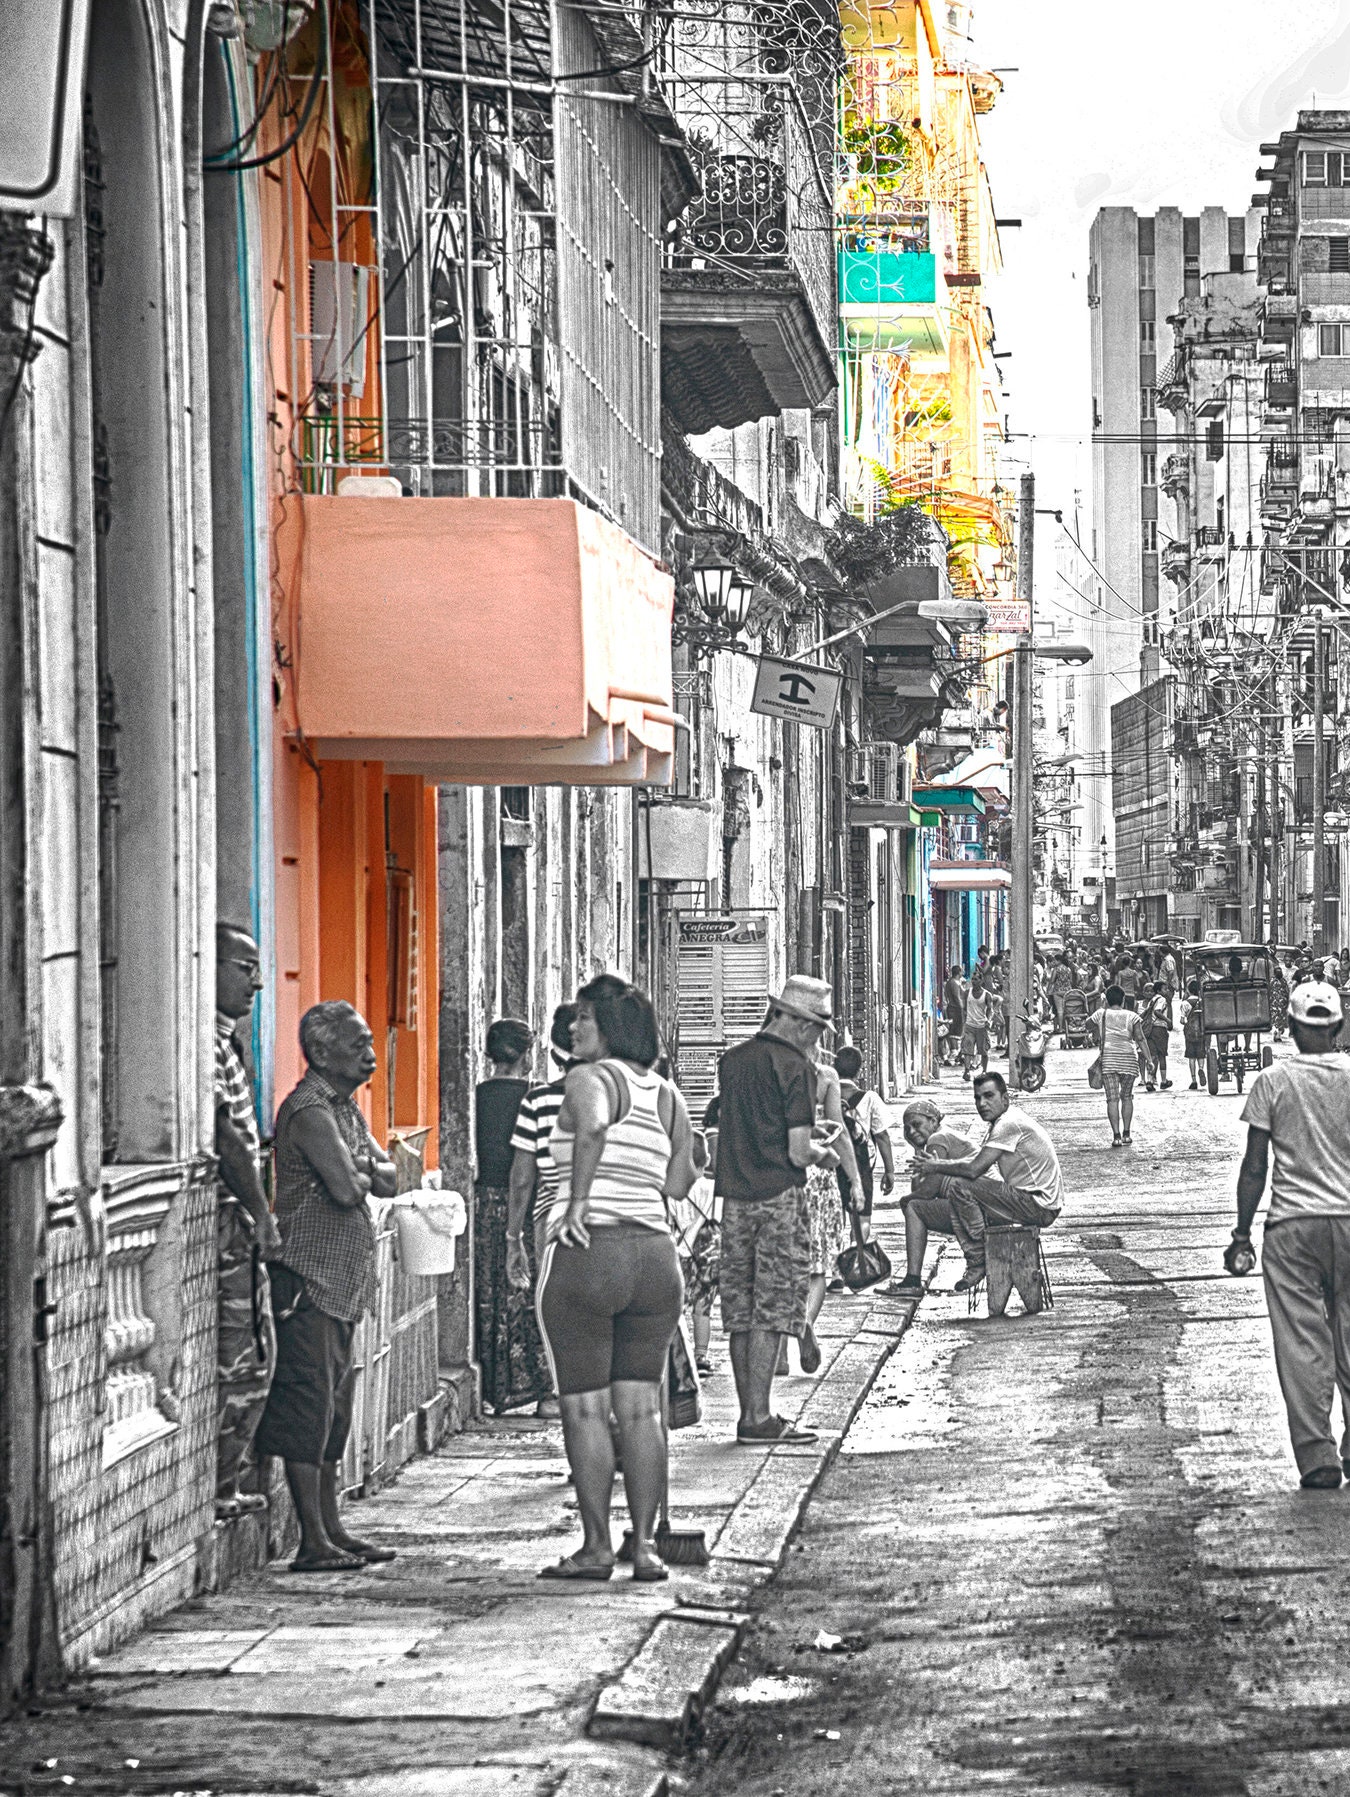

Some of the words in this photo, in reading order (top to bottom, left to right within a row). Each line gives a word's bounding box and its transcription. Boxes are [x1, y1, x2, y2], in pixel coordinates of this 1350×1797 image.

[761, 698, 796, 711] ARRENDADOR
[797, 707, 826, 719] INSCRIPTO
[783, 710, 802, 719] DIVISA
[683, 922, 730, 931] Cafeteria
[689, 933, 731, 942] NEGRA
